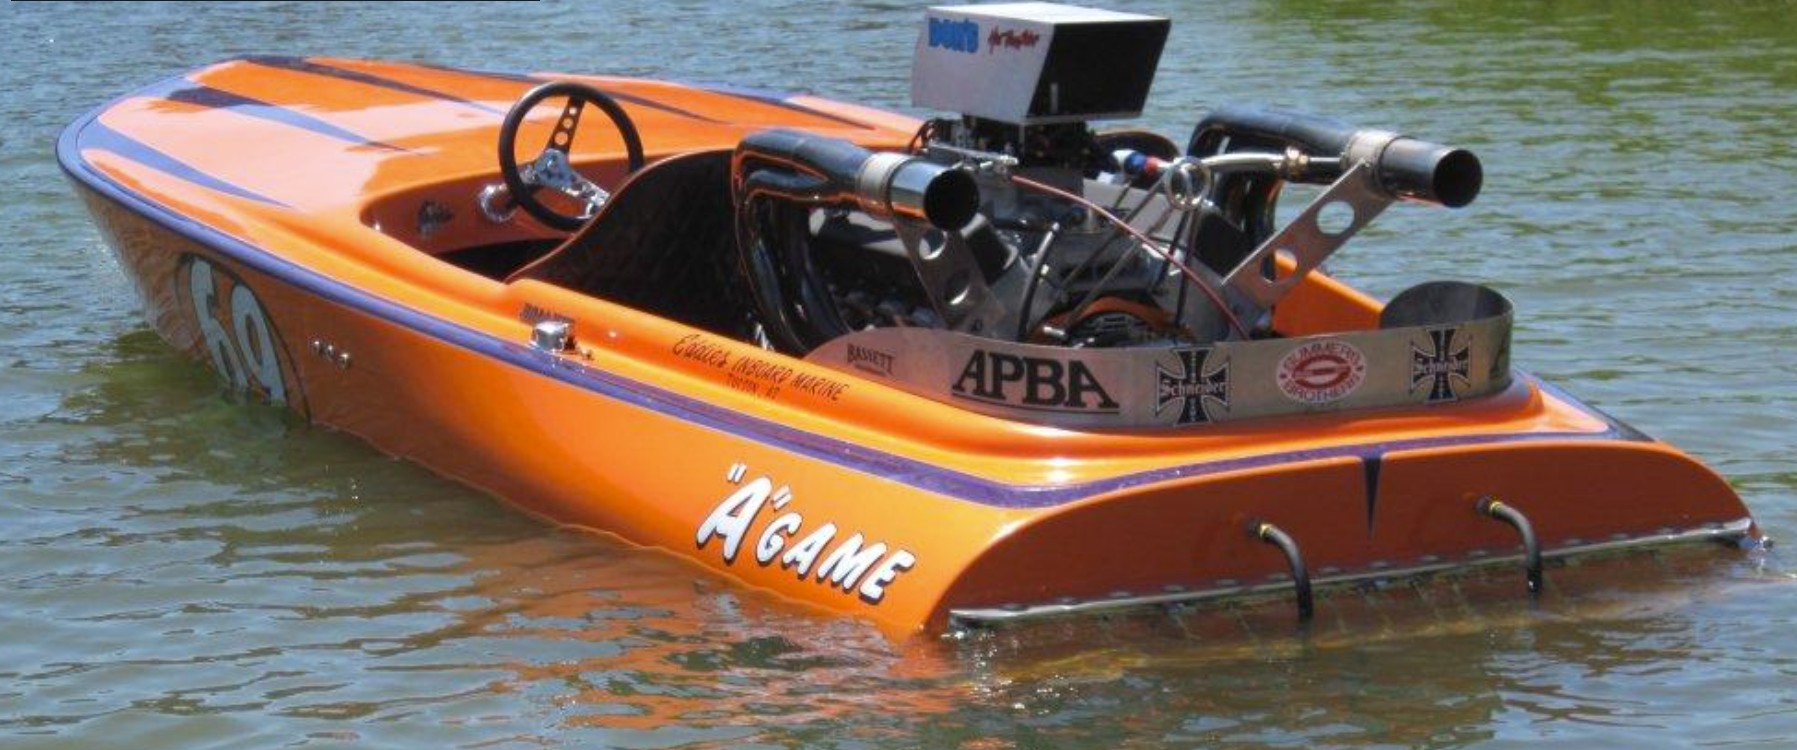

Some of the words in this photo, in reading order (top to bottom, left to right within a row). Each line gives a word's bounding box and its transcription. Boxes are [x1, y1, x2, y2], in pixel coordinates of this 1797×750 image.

[731, 356, 793, 385] INBOARD
[790, 372, 850, 401] MARINE
[847, 342, 895, 375] BASSETT
[952, 348, 1119, 409] APBA
[1160, 378, 1229, 398] Schneider
[756, 512, 917, 605] GAME
